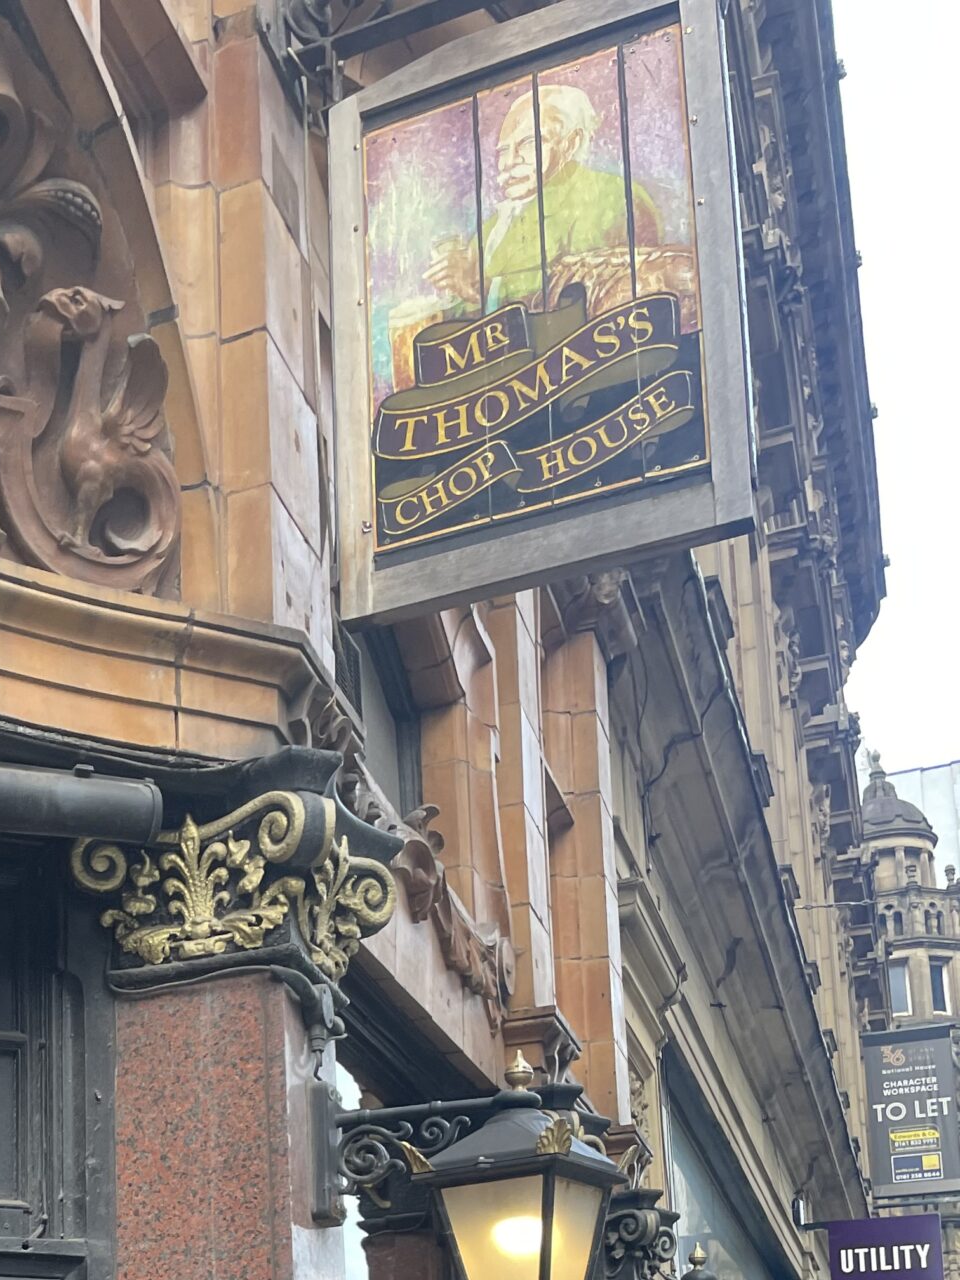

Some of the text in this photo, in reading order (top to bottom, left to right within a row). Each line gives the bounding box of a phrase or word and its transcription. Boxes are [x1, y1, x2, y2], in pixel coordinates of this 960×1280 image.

[441, 321, 510, 376] MR
[395, 306, 654, 453] THOMAS'S
[394, 389, 676, 527] CHOP HOUSE
[883, 1076, 937, 1088] CHARACTER
[883, 1084, 939, 1096] WORKSPACE
[872, 1097, 952, 1122] TO LET
[840, 1244, 930, 1273] UTILITY
